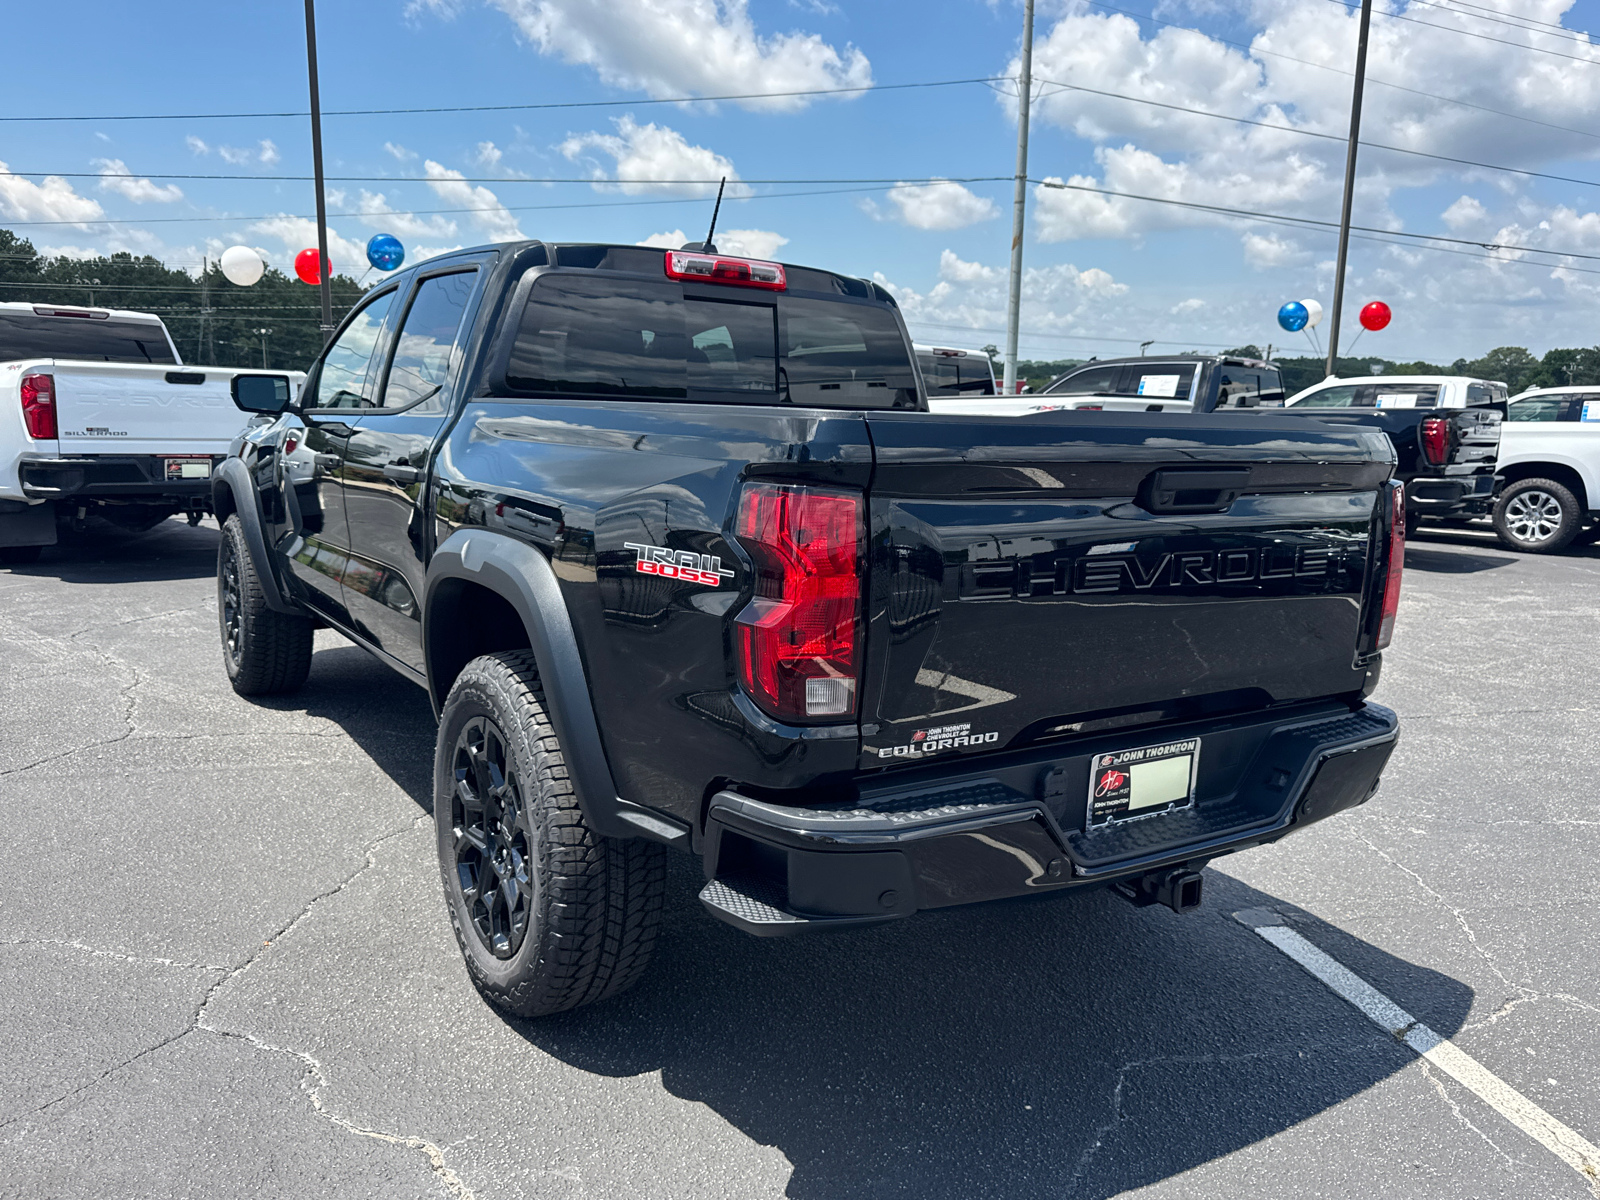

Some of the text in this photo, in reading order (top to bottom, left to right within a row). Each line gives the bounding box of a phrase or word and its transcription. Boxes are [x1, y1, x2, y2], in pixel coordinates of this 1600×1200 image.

[76, 391, 236, 409] CHEVRO
[624, 541, 735, 578] TRAIL
[636, 559, 720, 587] BOSS
[926, 731, 960, 741] CHEVROLET
[927, 724, 971, 736] JOHN THORNTON
[878, 731, 999, 758] COLORADO
[1120, 742, 1195, 762] JOHN THORNTON
[1106, 798, 1129, 806] THORNTON
